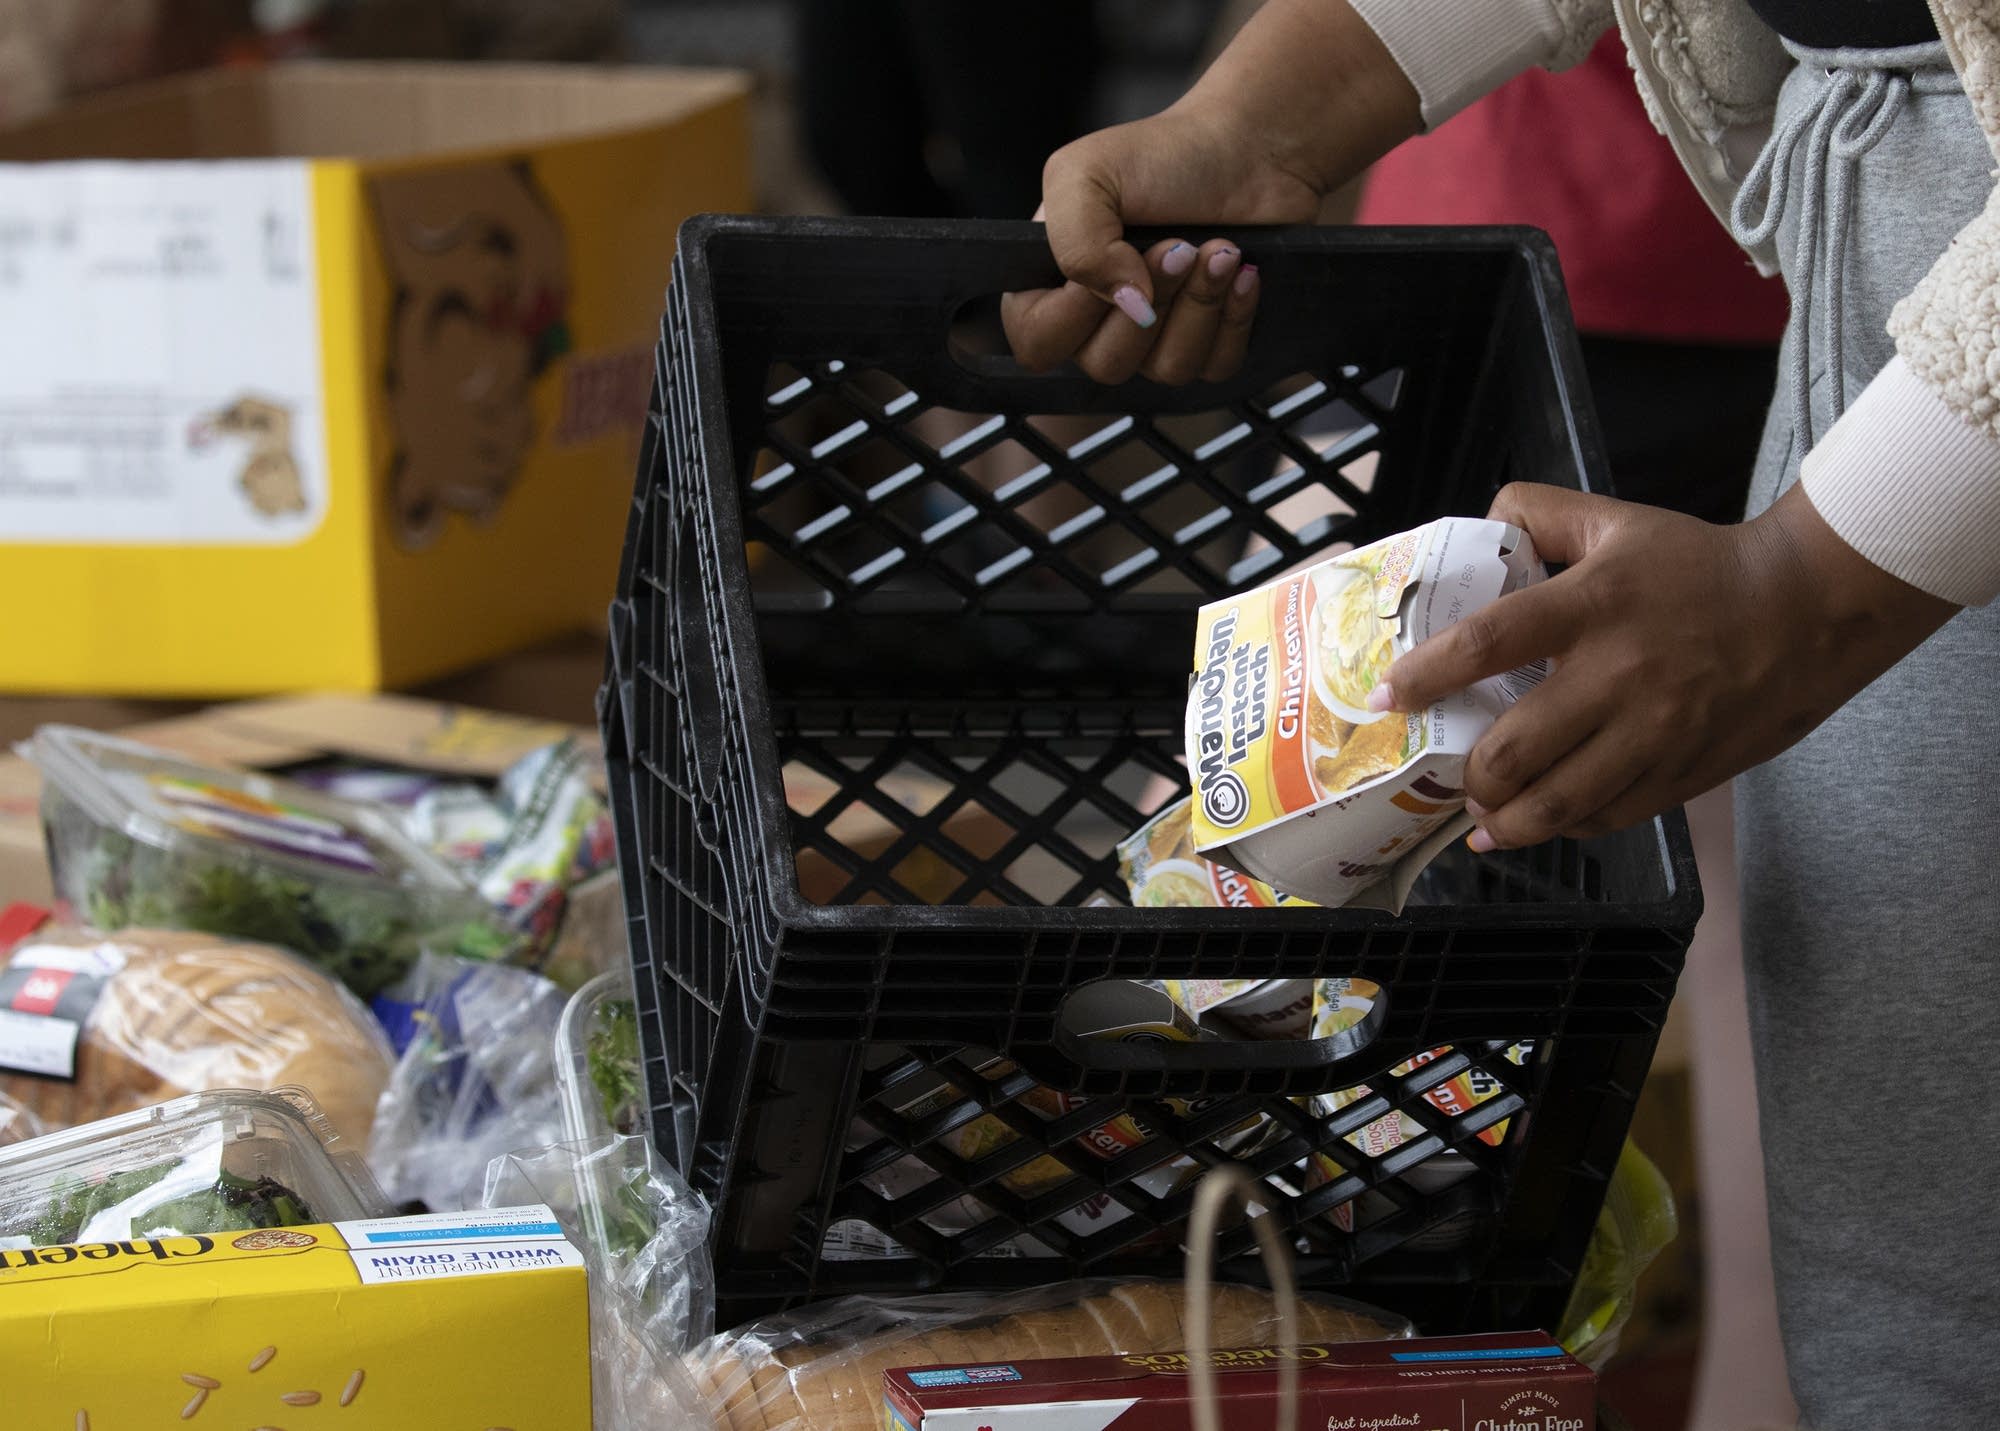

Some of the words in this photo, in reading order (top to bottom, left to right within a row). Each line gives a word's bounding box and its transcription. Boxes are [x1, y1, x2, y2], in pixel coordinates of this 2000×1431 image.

[1284, 583, 1300, 625] Flavor
[1278, 624, 1303, 740] Chicken
[1199, 614, 1237, 792] Maruchan
[1227, 641, 1251, 765] Instant
[1247, 643, 1269, 744] Lunch
[1433, 722, 1445, 747] BEST
[1367, 1122, 1385, 1153] Soup
[371, 1253, 457, 1267] GRAIN
[462, 1248, 561, 1262] WHOLE
[506, 1256, 564, 1269] FIRST
[378, 1260, 500, 1278] INGREDIENT
[1122, 1346, 1330, 1366] Cheeios
[1435, 1368, 1477, 1376] Grain
[1479, 1366, 1527, 1374] Whole
[1500, 1390, 1532, 1411] SIMPLY
[1534, 1391, 1560, 1408] MADE
[1327, 1416, 1356, 1431] first
[1359, 1413, 1421, 1429] ingredient
[1544, 1415, 1584, 1431] Free
